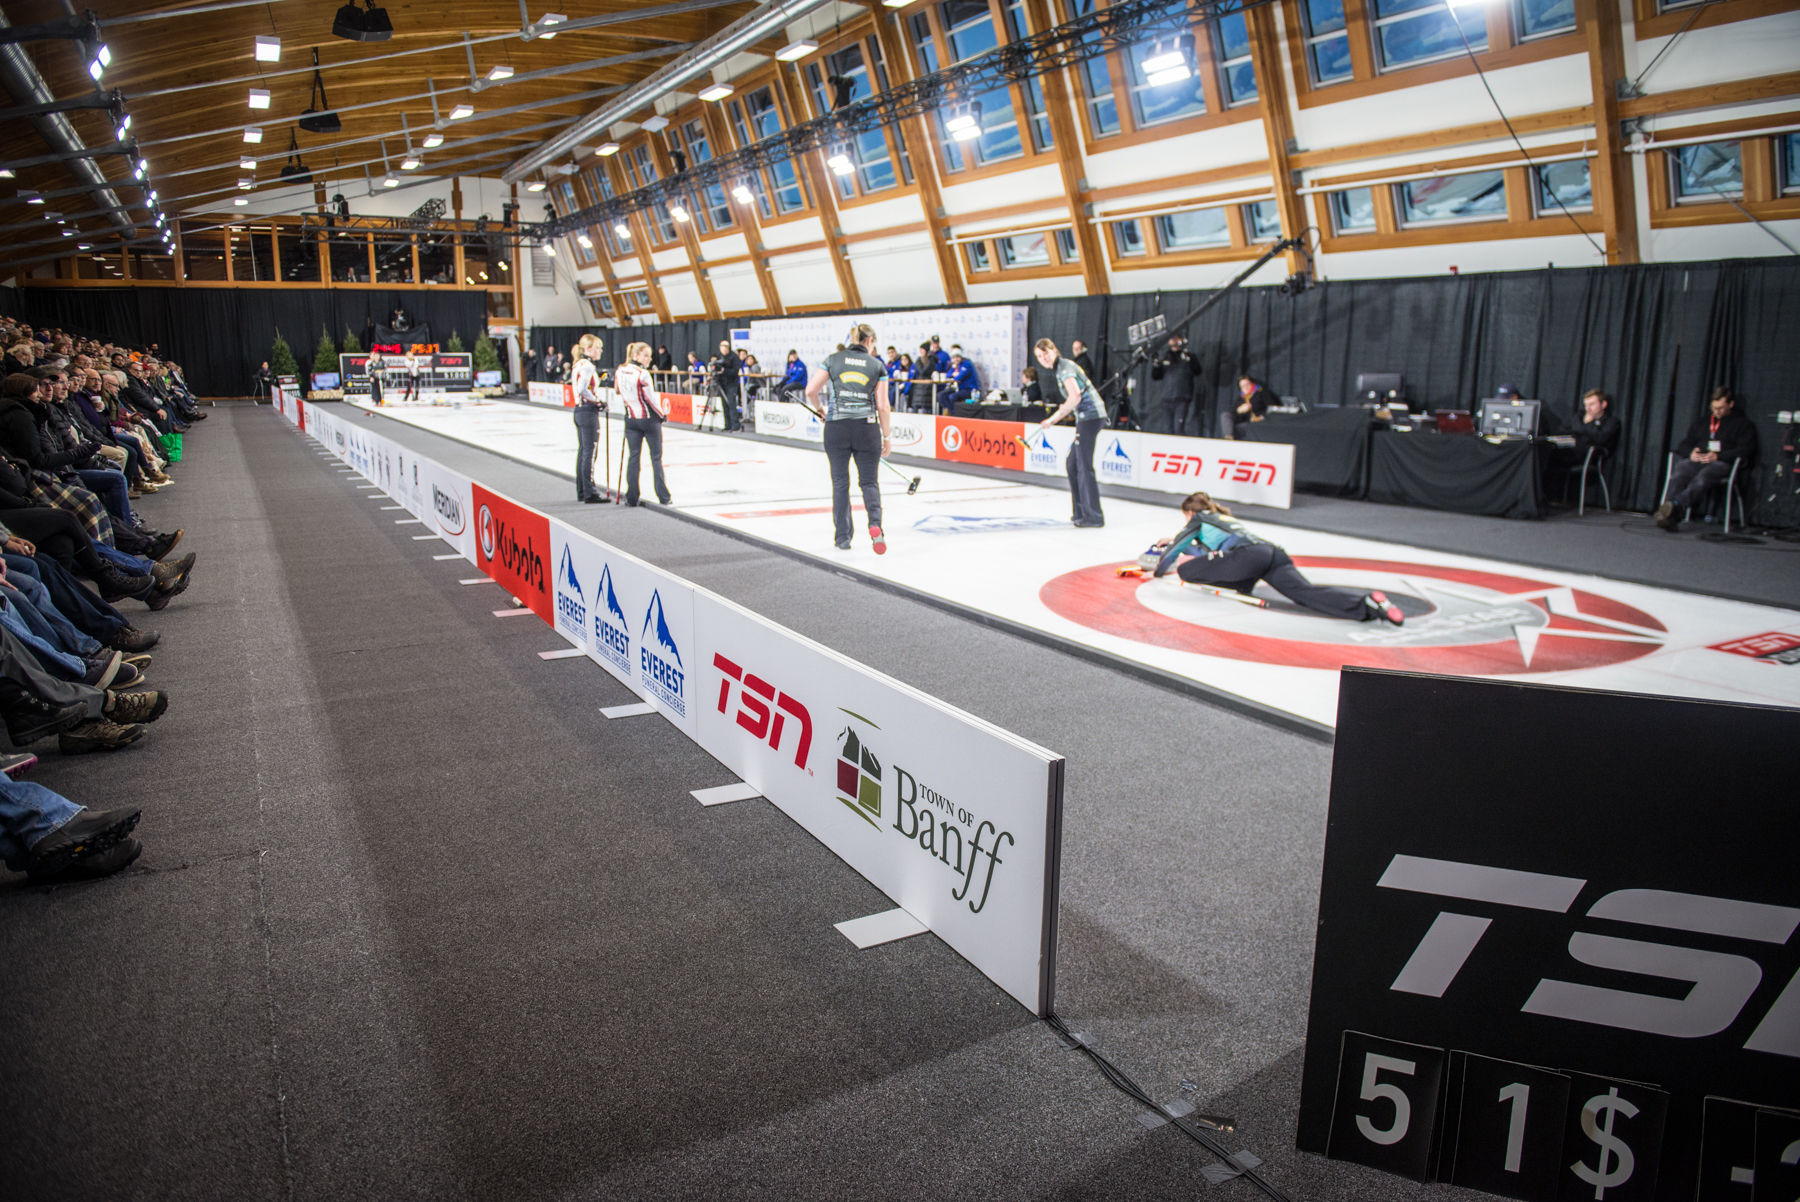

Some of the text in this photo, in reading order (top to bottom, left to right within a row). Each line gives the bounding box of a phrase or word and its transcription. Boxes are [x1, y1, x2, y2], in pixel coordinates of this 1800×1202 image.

[845, 357, 867, 367] MOORE
[763, 411, 790, 426] MERIDIAN
[965, 430, 1017, 457] Kubota
[1031, 453, 1057, 463] EVEREST
[1102, 461, 1132, 473] EVEREST
[1151, 453, 1276, 486] TSN TSN
[432, 483, 460, 527] MERIDIAN
[496, 518, 545, 594] Kubota
[558, 591, 586, 627] EVEREST
[595, 615, 629, 658] EVEREST
[641, 646, 684, 698] EVEREST
[642, 674, 685, 715] FUNERAL CONCIERGE
[713, 652, 812, 771] TSN
[919, 783, 975, 828] TOWN OF
[893, 765, 1014, 914] Banff
[1376, 854, 1800, 1057] TS
[1355, 1052, 1416, 1145] 5
